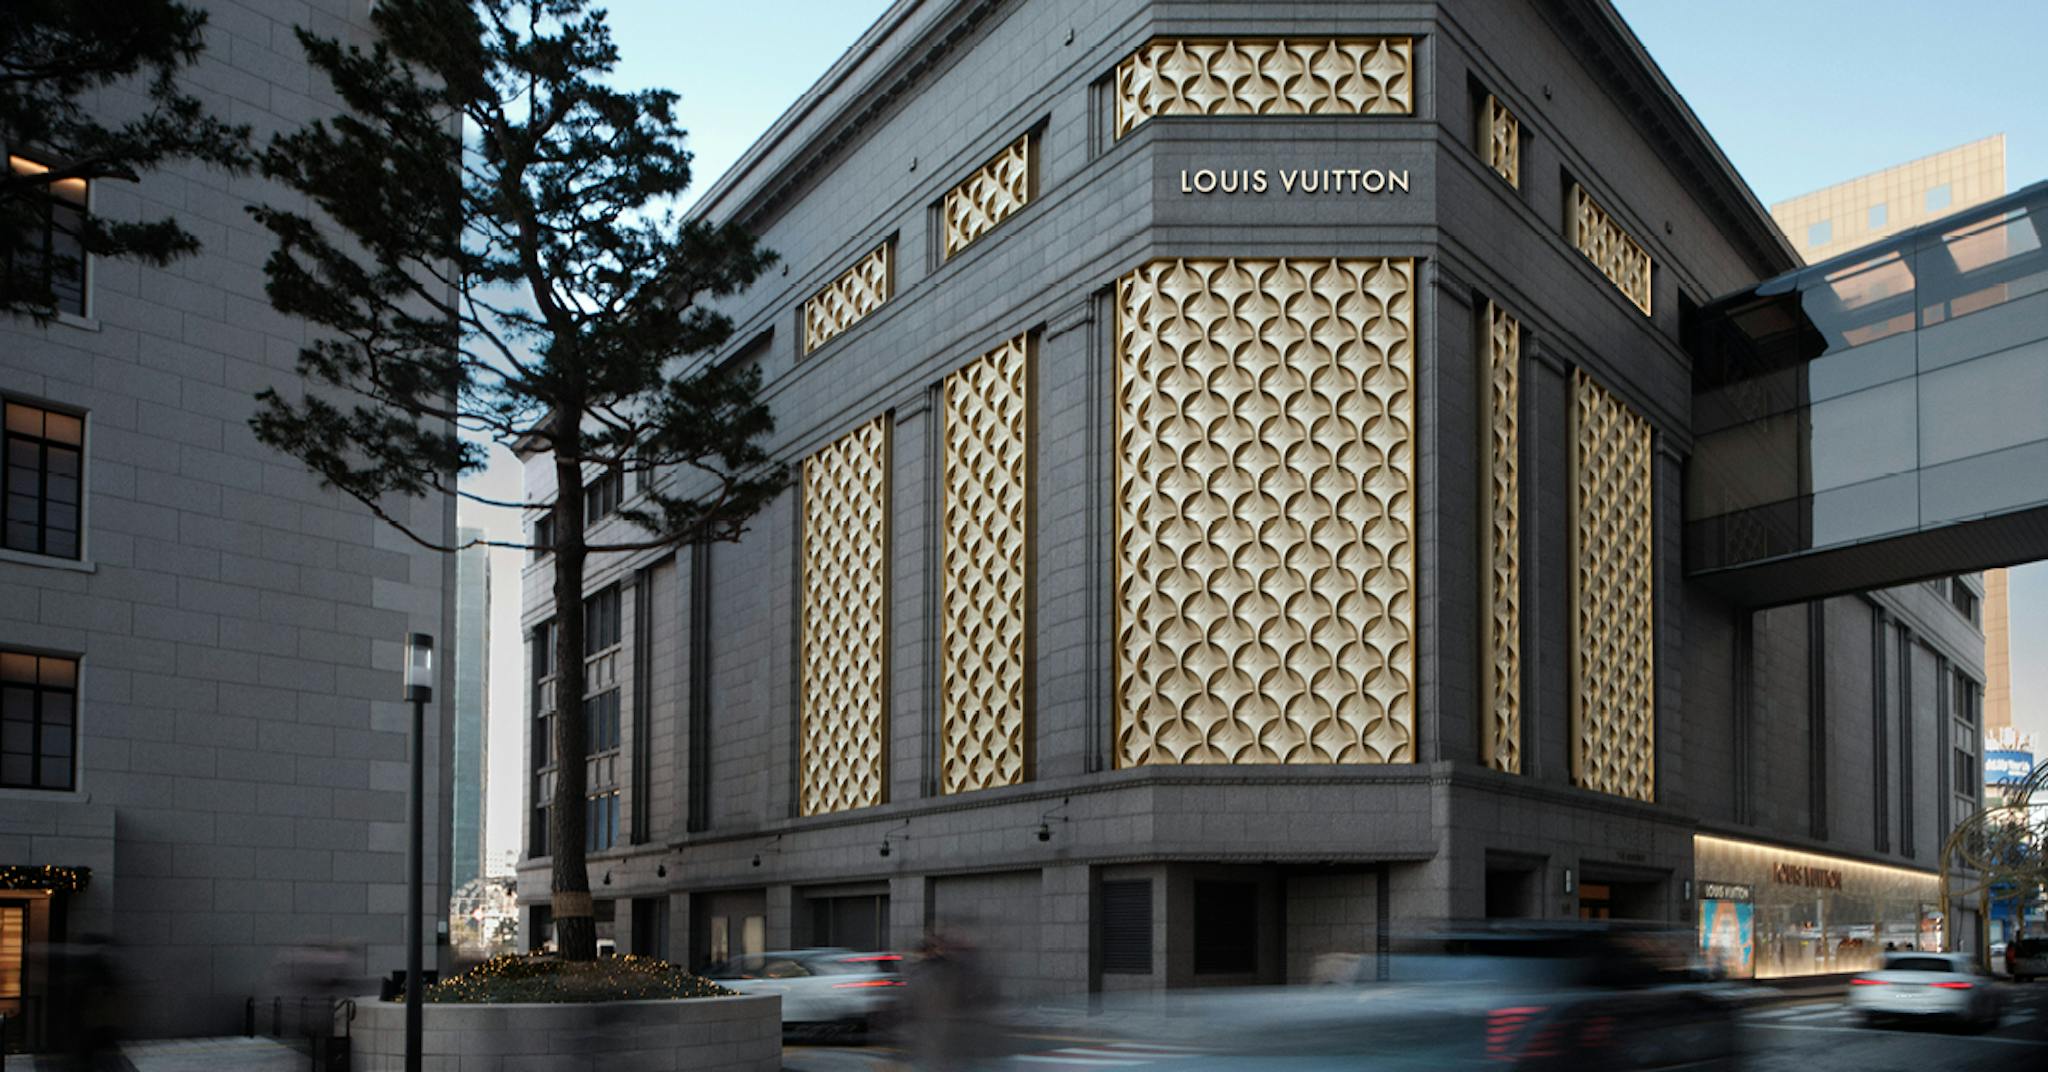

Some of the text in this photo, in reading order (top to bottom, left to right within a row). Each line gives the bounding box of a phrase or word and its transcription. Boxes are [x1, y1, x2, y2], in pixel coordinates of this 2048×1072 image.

[1181, 169, 1410, 193] LOUIS VUITTON
[1705, 884, 1749, 899] LOUIS VUITTON
